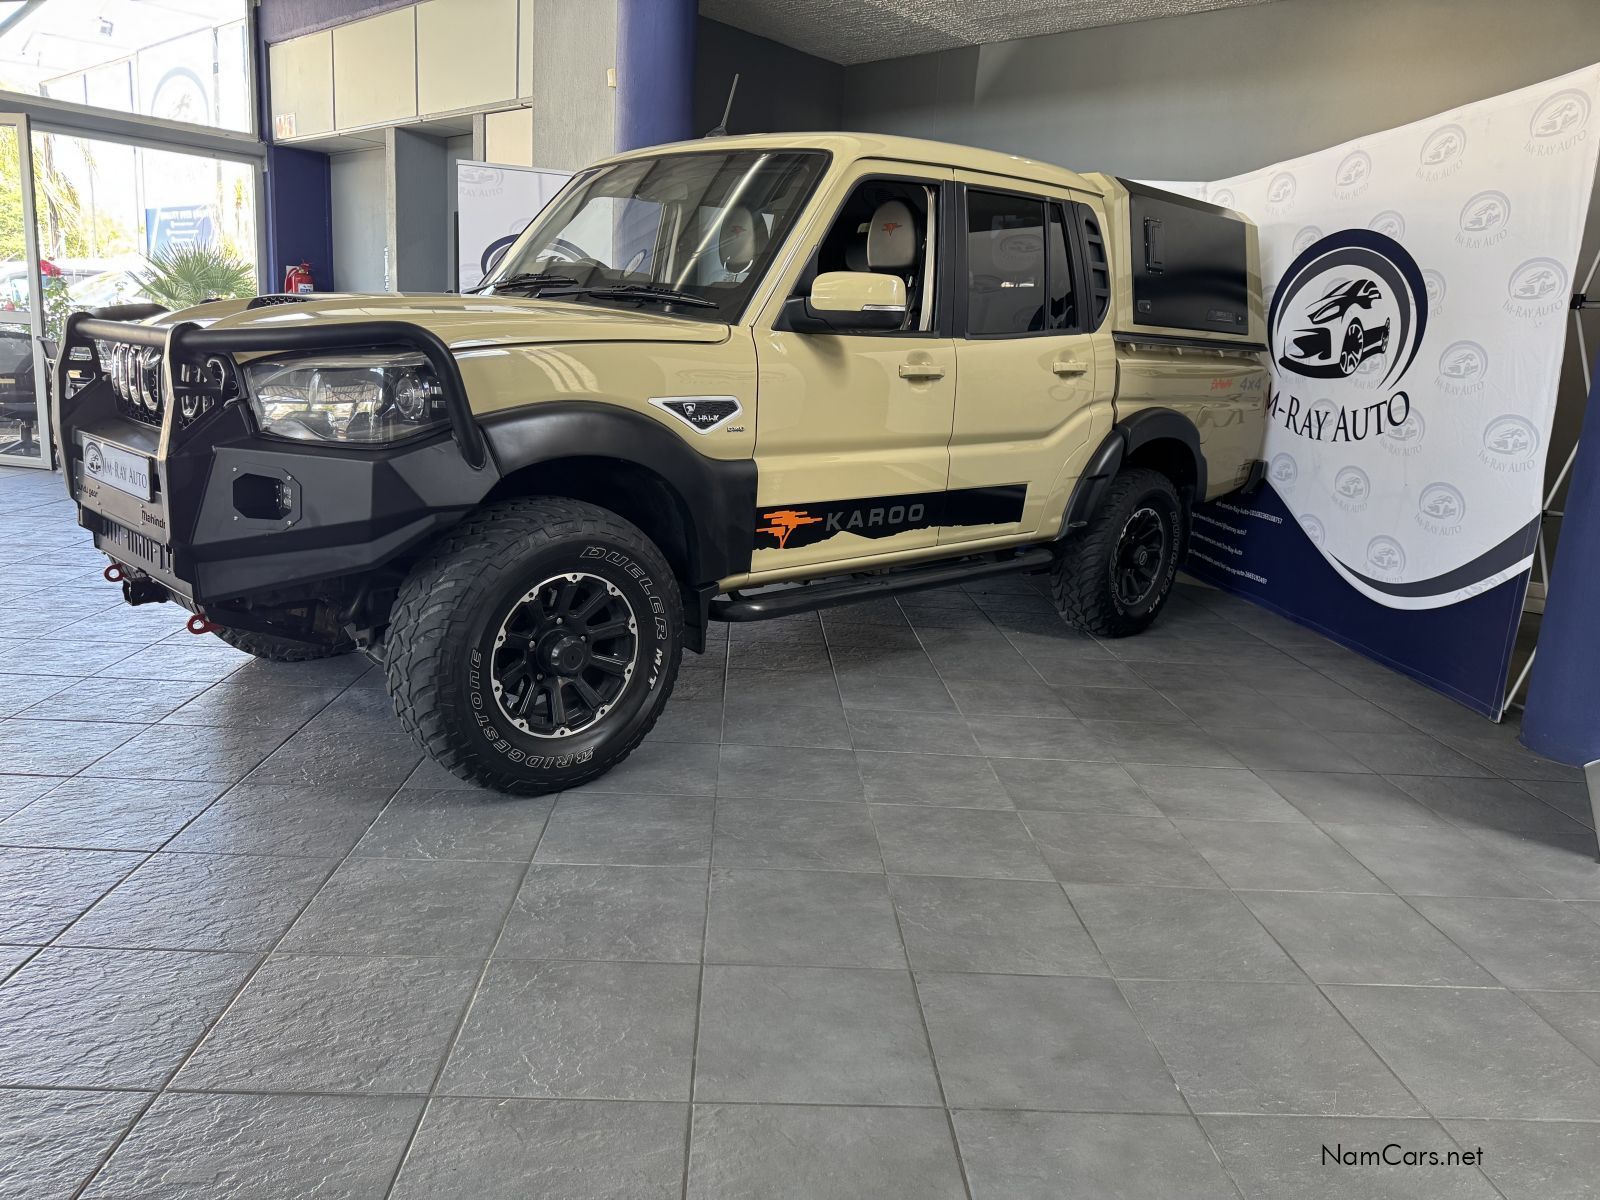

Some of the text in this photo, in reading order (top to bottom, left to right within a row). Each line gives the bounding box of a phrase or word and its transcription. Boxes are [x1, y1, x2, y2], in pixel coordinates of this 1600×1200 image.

[1555, 129, 1587, 154] AUTO
[1266, 381, 1410, 443] M-RAY AUTO
[128, 467, 148, 489] AUTO
[1507, 459, 1535, 473] AUTO
[825, 503, 925, 532] KAROO
[579, 546, 668, 691] DUELER M/T
[470, 648, 594, 770] BRIDGESTONE
